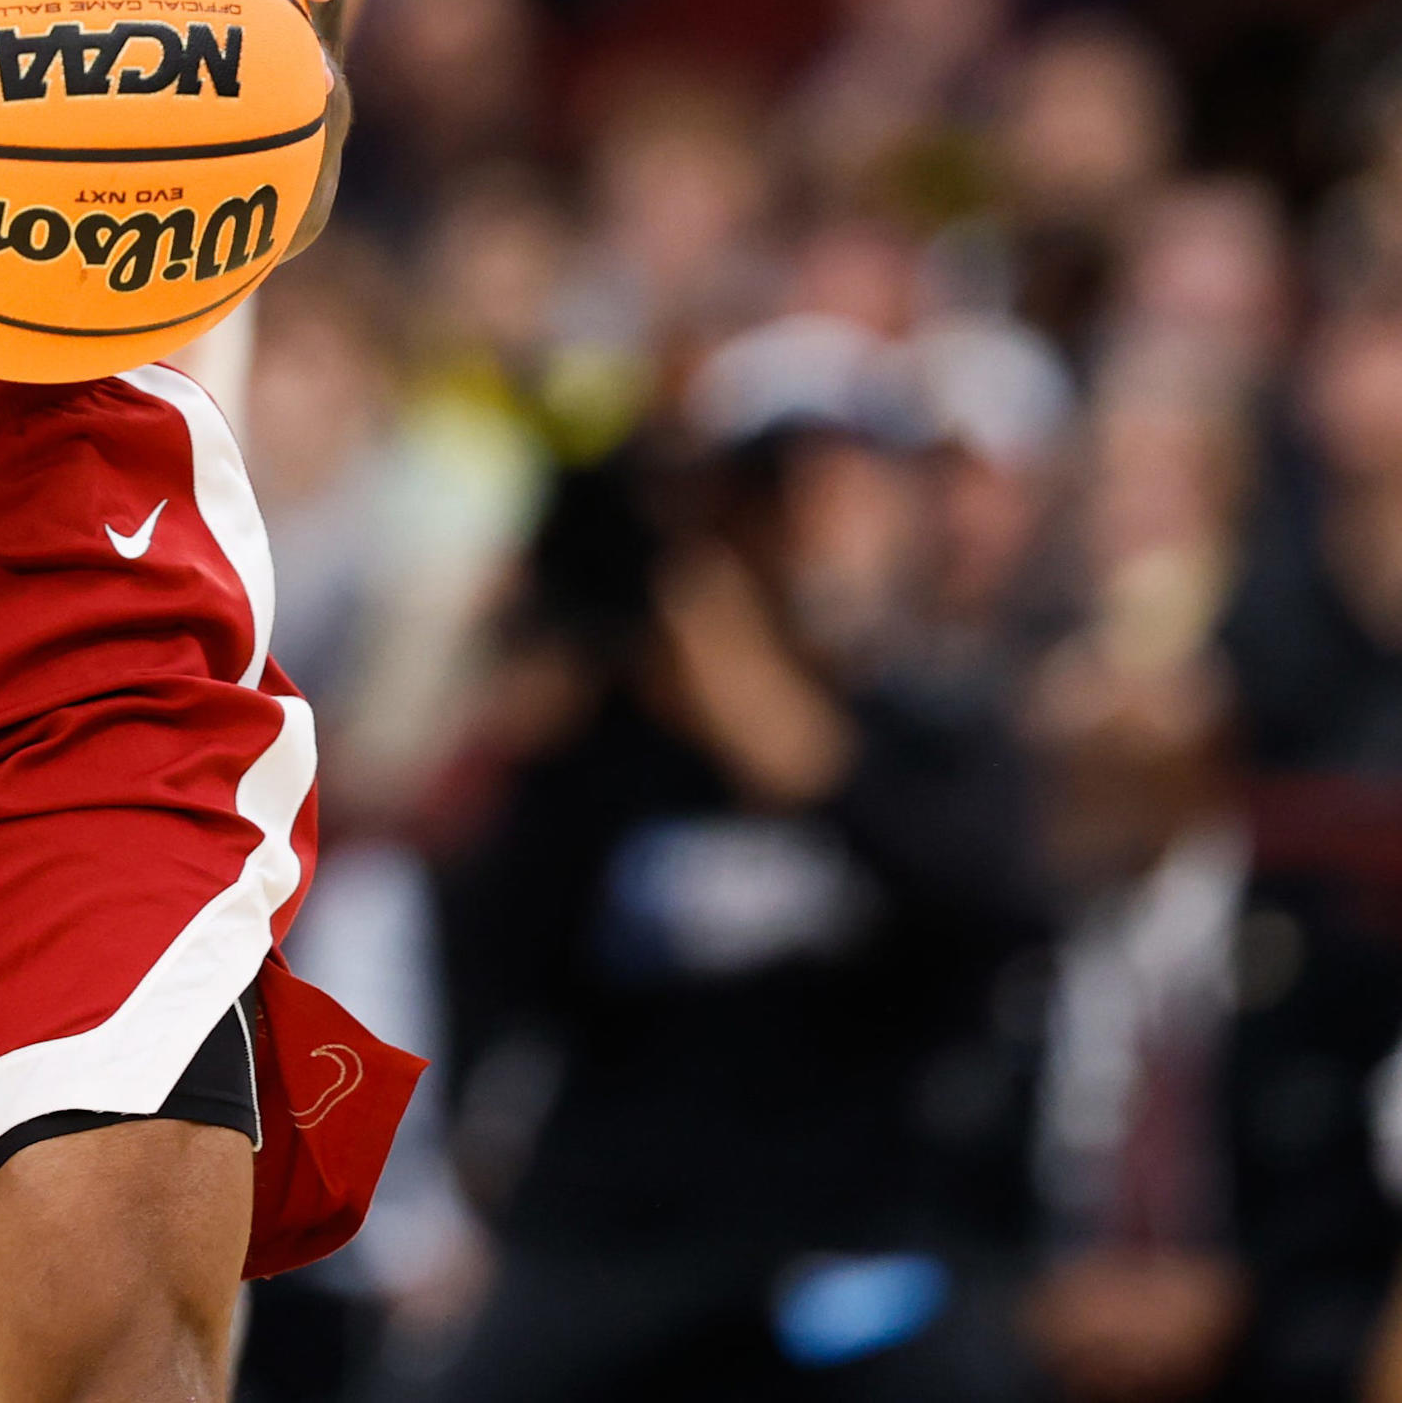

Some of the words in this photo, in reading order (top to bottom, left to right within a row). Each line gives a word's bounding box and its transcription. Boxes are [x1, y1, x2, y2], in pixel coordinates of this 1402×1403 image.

[70, 0, 142, 13] GAME
[149, 0, 242, 15] OFFICIAL
[74, 189, 127, 204] NXT
[136, 187, 184, 202] EVO
